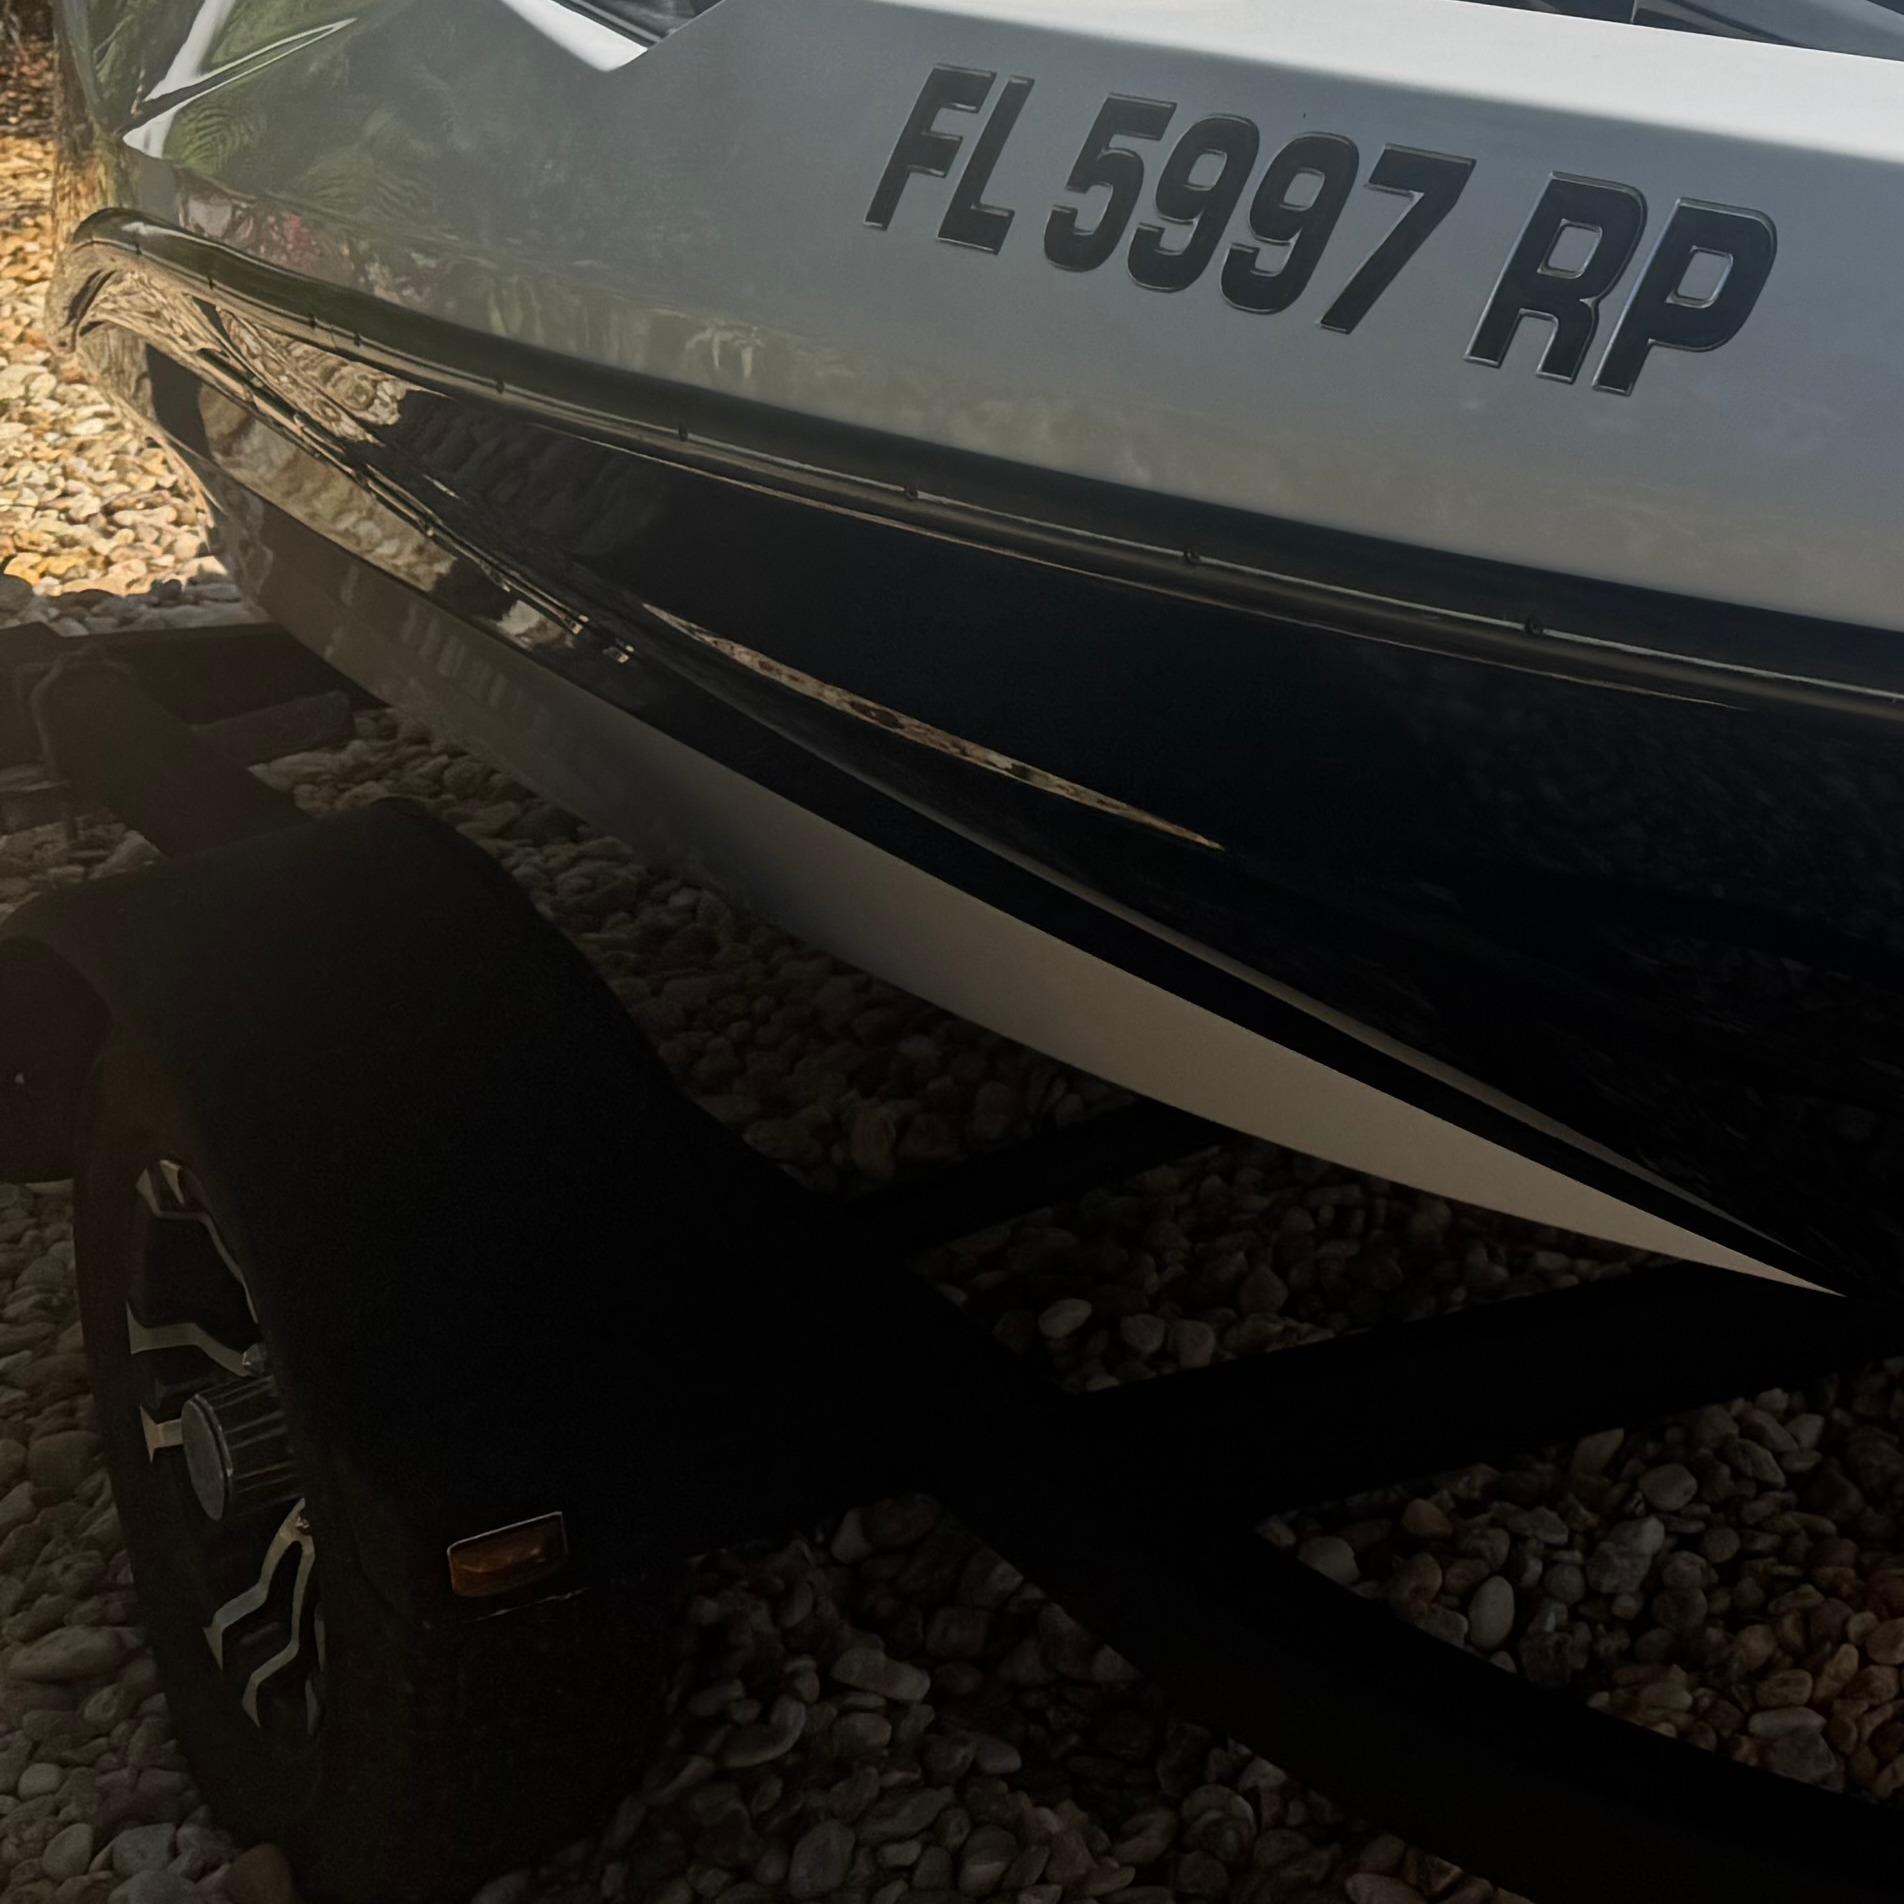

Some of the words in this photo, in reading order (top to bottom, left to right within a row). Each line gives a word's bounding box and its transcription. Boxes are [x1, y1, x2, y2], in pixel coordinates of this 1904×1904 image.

[862, 62, 1035, 255] FL
[1042, 93, 1477, 335] 5997
[1463, 170, 1778, 397] RP
